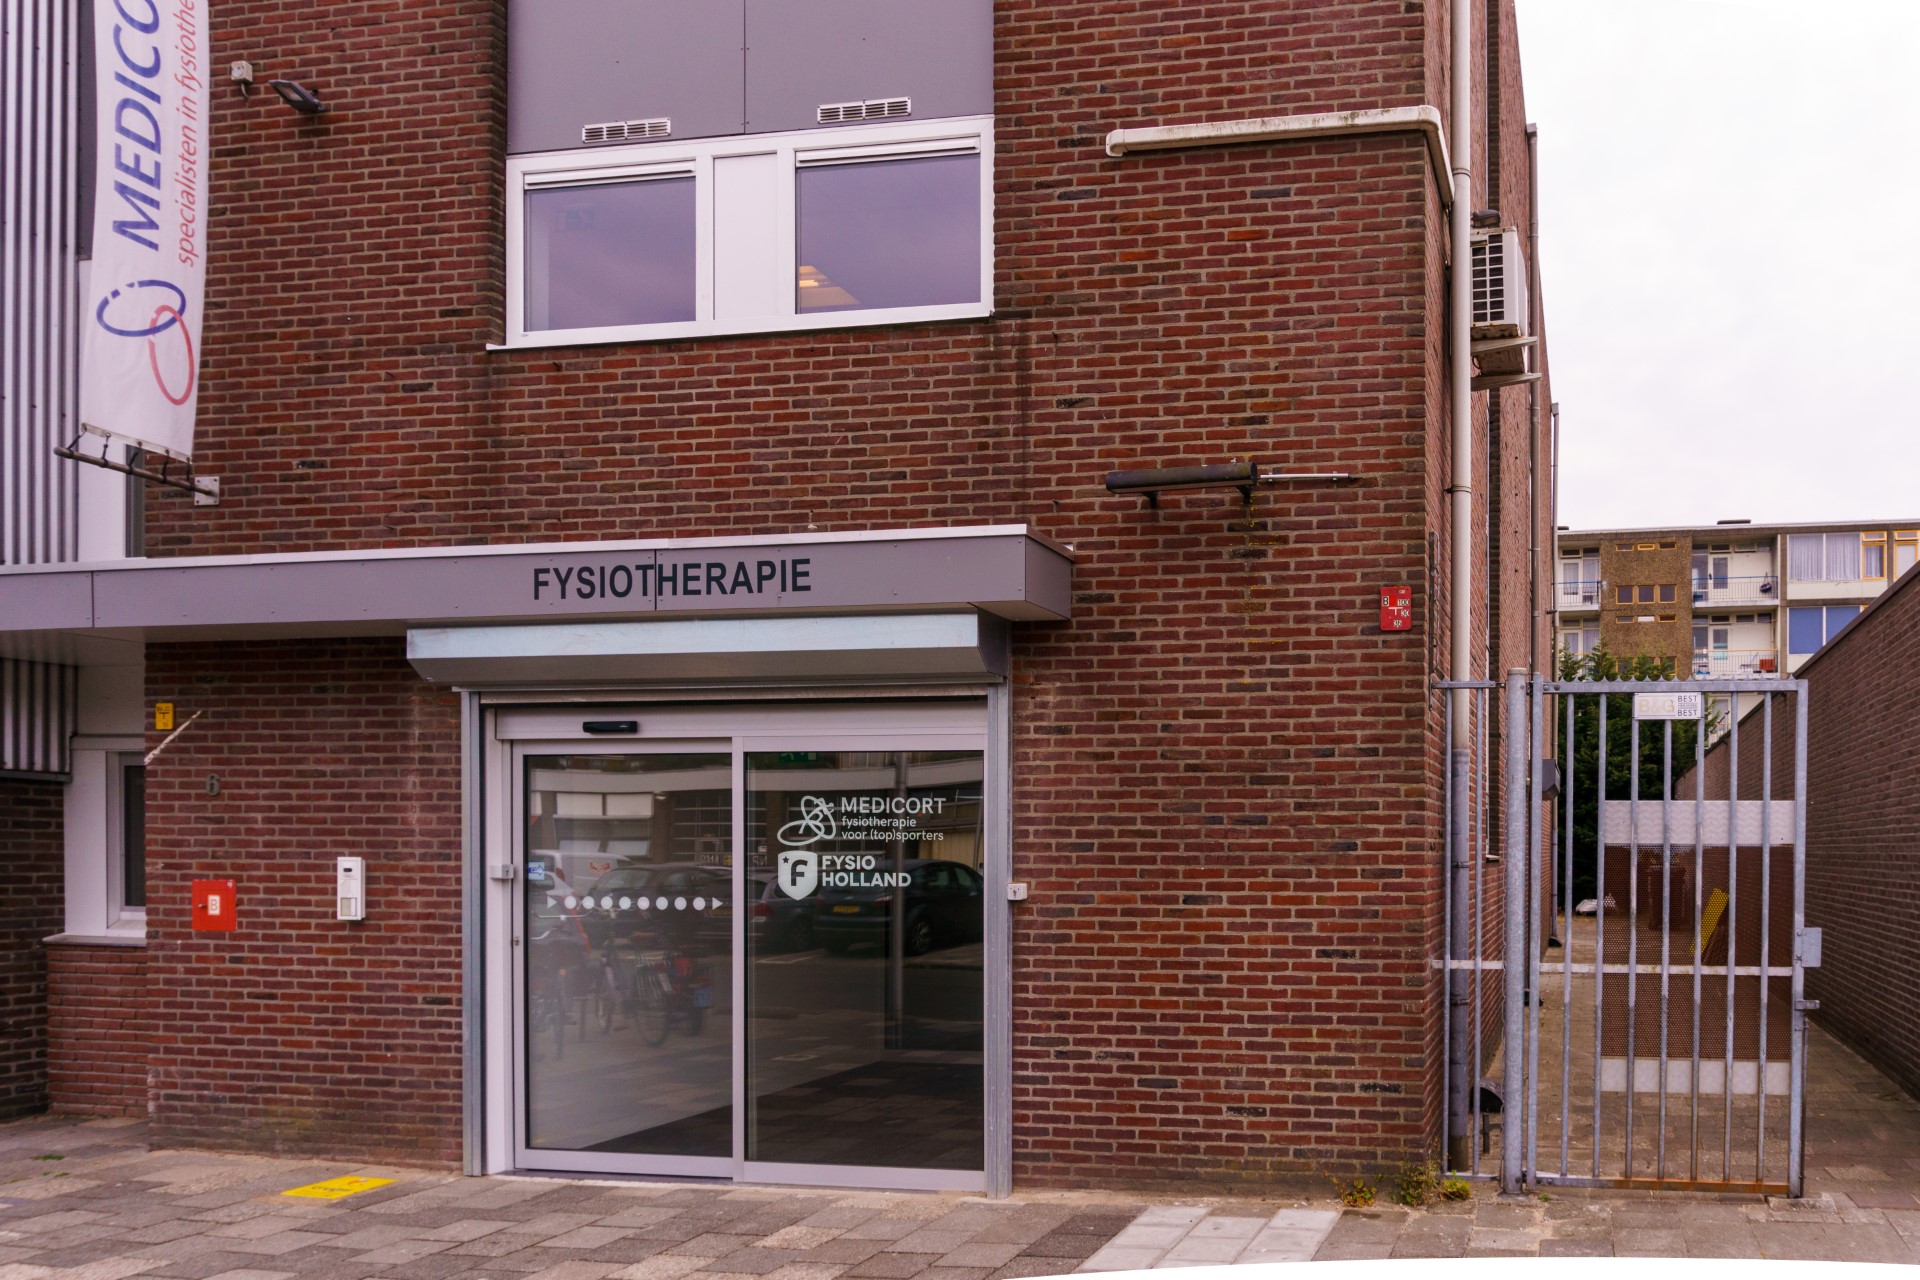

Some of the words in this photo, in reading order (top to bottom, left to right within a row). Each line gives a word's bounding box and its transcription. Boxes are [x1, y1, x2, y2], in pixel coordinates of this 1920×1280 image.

[176, 95, 198, 121] in
[174, 124, 200, 268] specialisten
[533, 558, 812, 600] FYSIOTHERAPIE
[1677, 709, 1698, 717] BEST
[205, 773, 220, 796] 6
[841, 797, 946, 814] MEDICORT
[841, 816, 917, 829] fysiotherapie
[841, 830, 867, 840] voor
[870, 829, 944, 843] (top)sporters
[822, 855, 876, 870] FYSIO
[822, 872, 912, 887] HOLLAND
[210, 898, 218, 911] B
